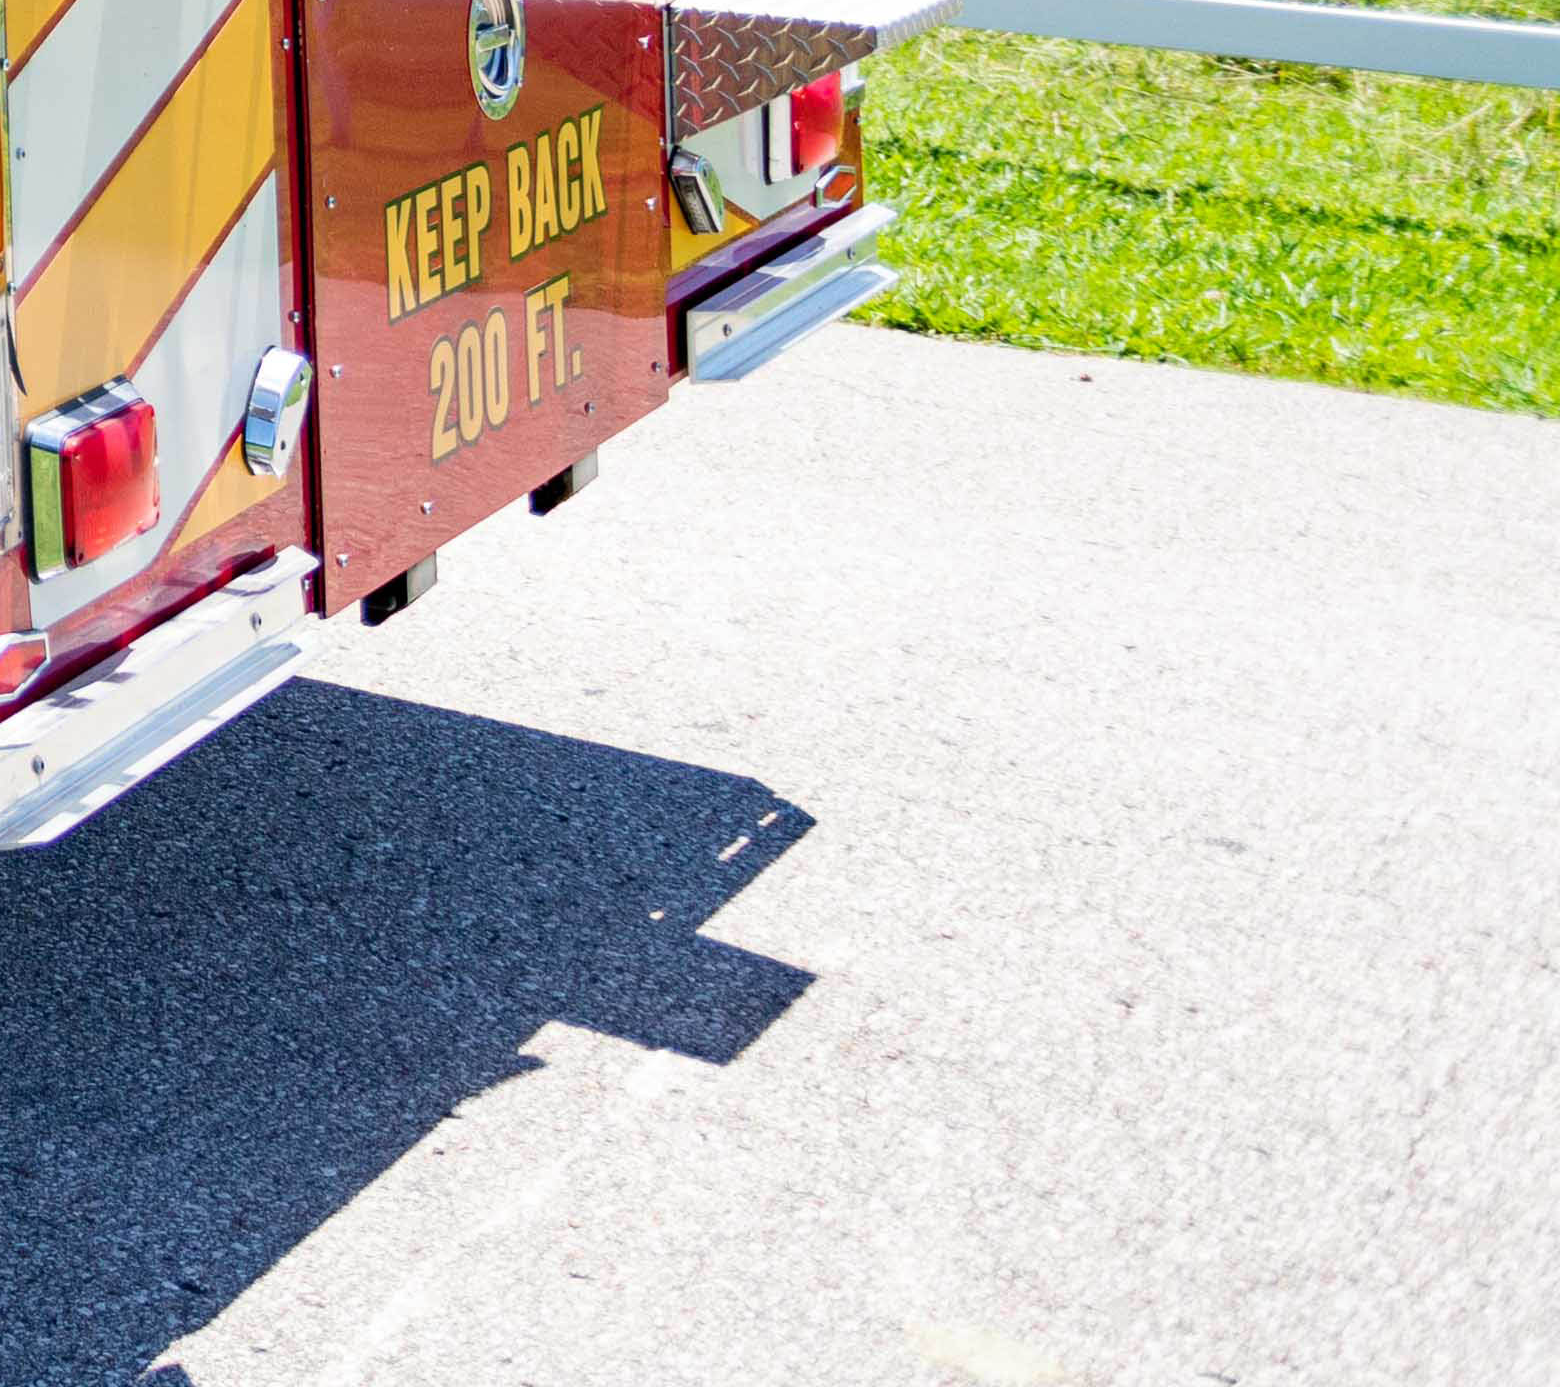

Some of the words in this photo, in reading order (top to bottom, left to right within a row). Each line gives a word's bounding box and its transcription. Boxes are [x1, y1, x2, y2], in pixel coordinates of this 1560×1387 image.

[384, 161, 491, 324] KEEP
[506, 104, 607, 263] BACK
[428, 306, 510, 465] 200
[524, 272, 584, 406] FT.
